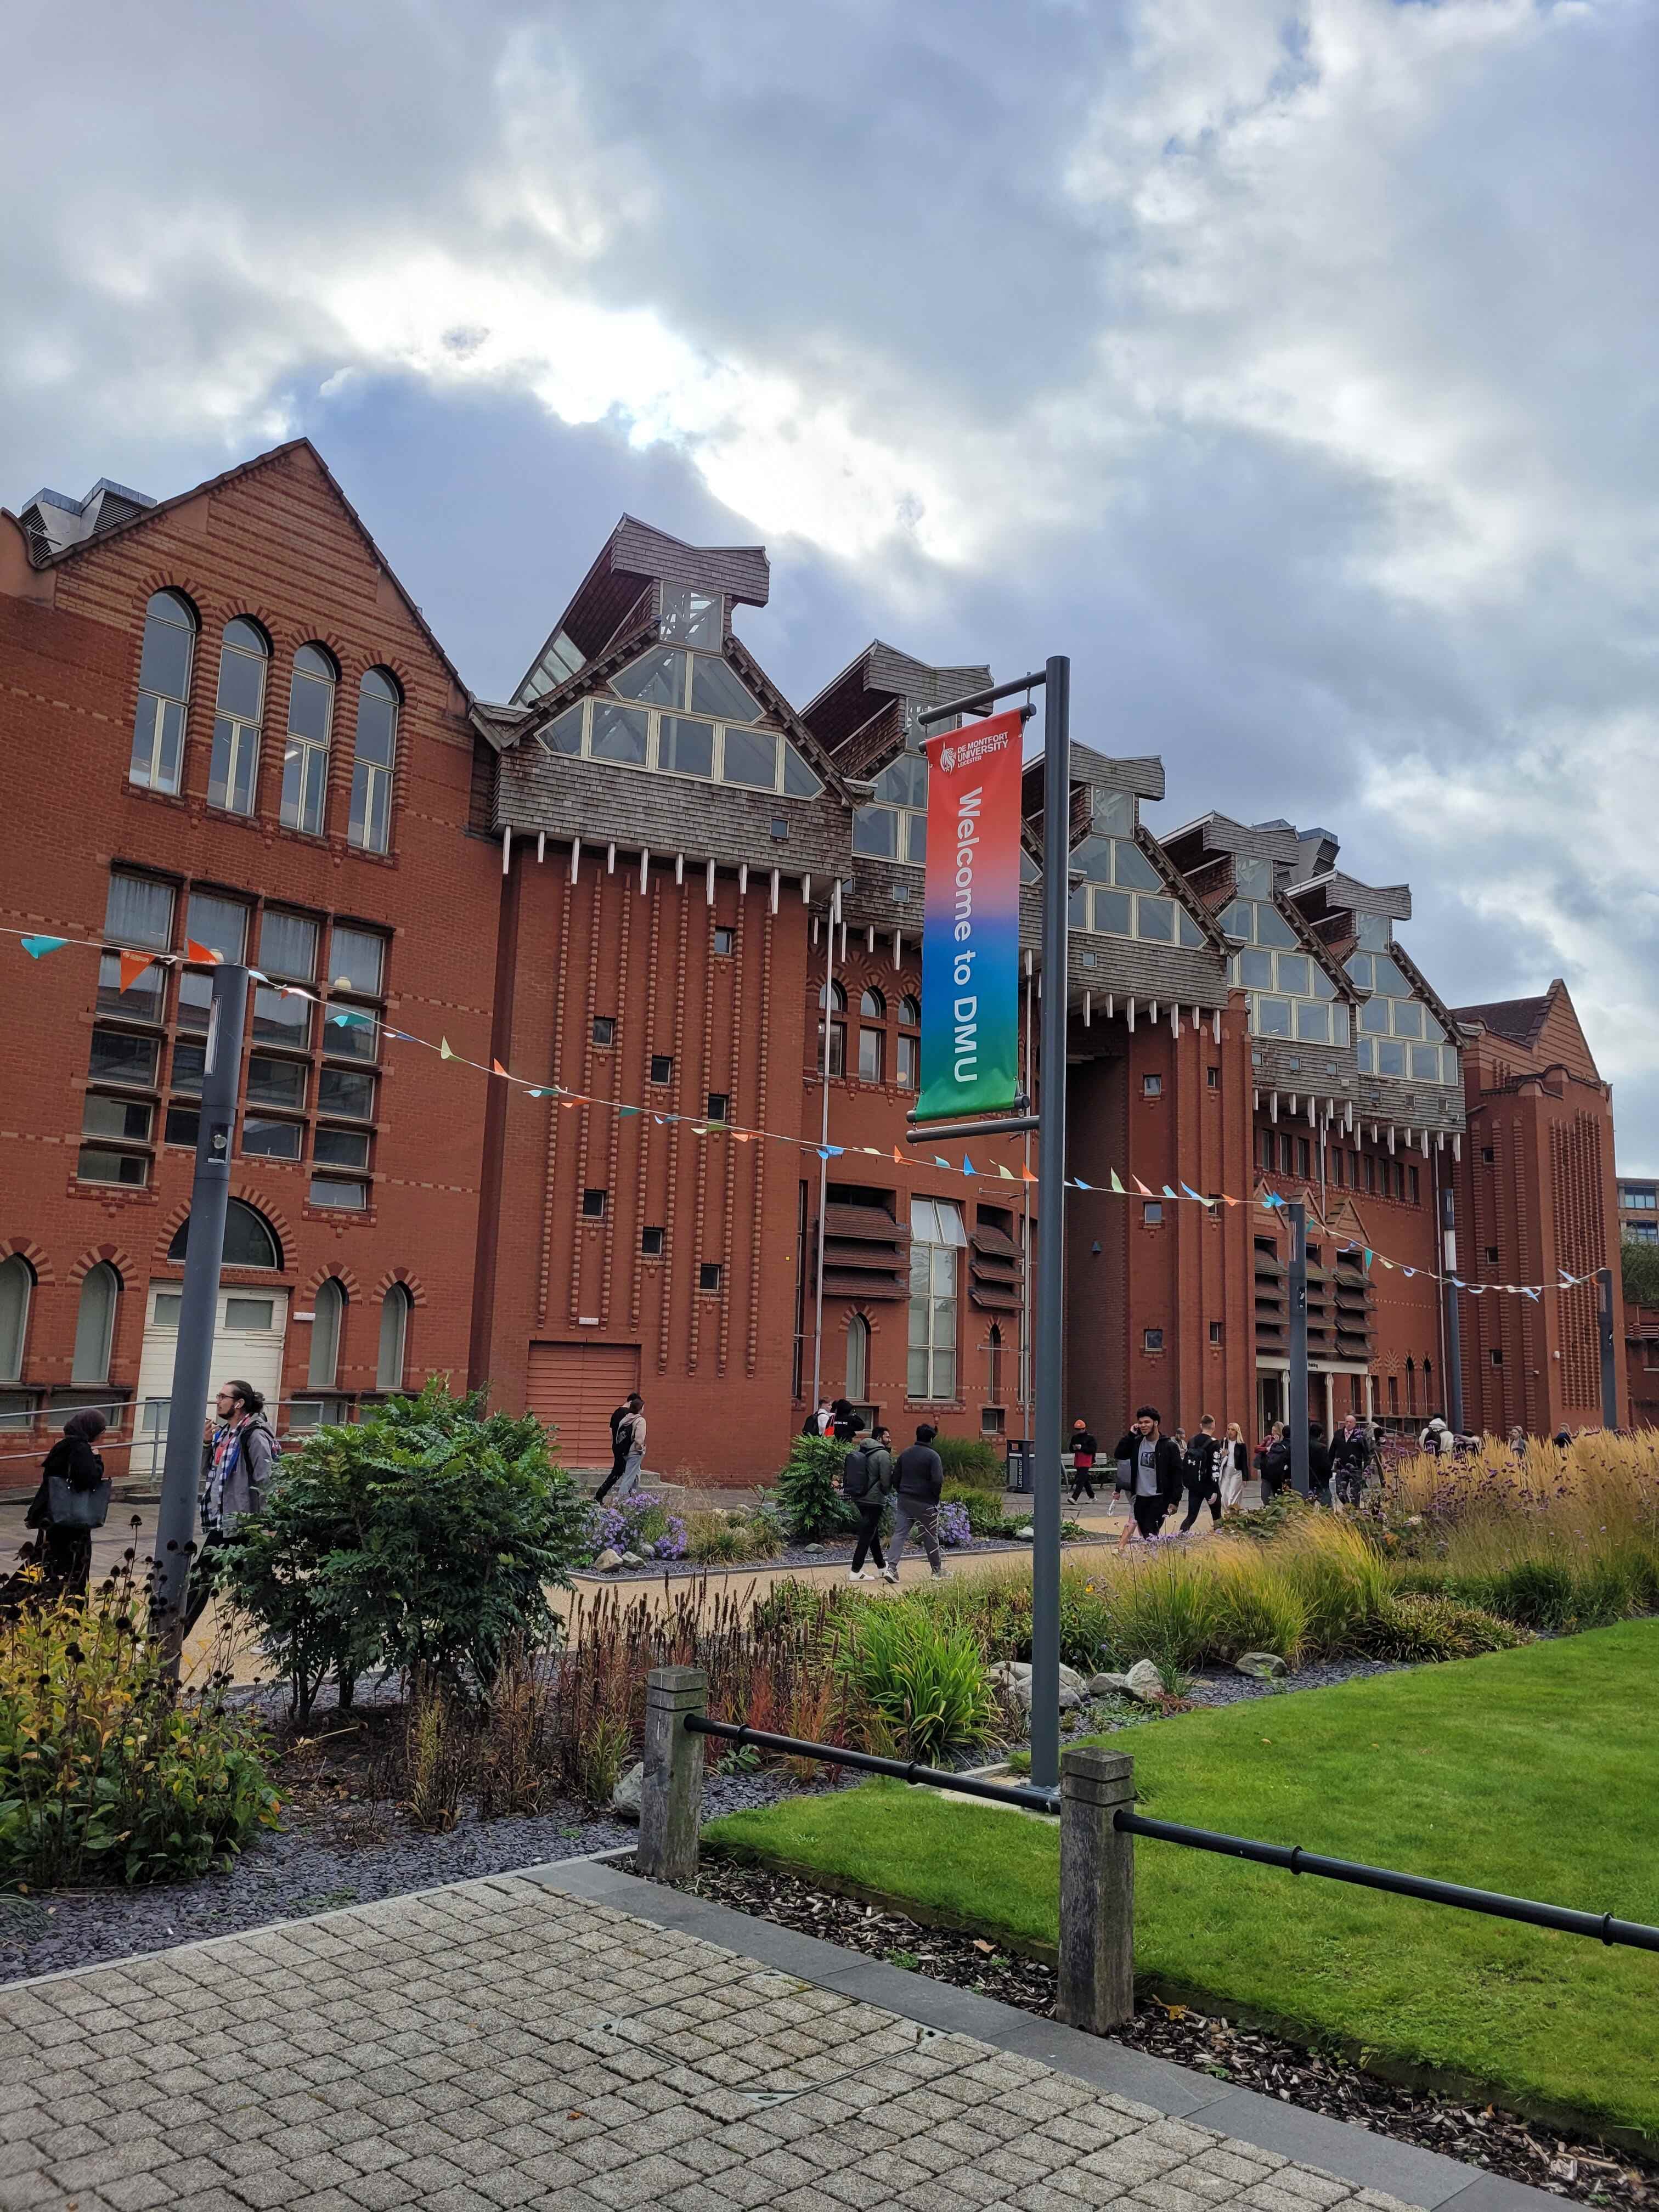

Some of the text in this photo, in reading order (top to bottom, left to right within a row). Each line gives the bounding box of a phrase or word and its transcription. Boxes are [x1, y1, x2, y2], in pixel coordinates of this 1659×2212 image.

[957, 731, 1008, 754] DE MONTFORT
[957, 739, 1009, 762] UNIVERSITY
[957, 755, 982, 768] LEICESTER
[954, 786, 983, 1082] Welcome to DMU
